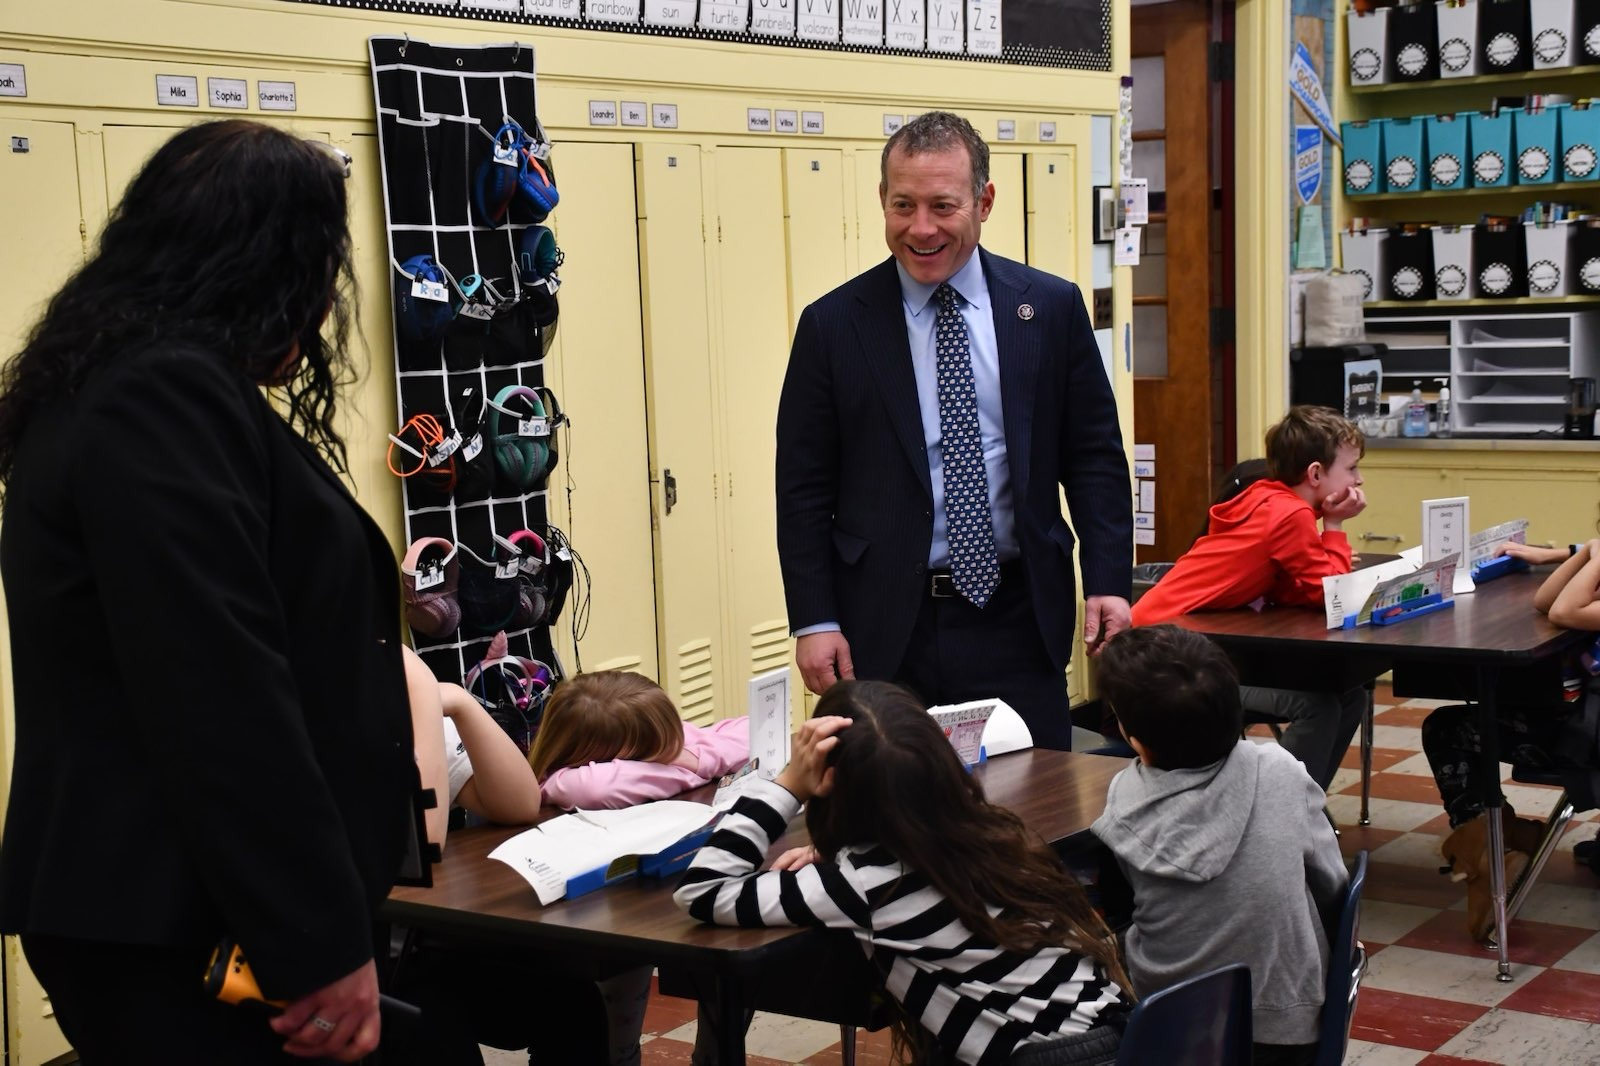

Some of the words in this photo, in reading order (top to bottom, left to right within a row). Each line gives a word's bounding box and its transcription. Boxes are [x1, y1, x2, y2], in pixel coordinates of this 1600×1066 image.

[591, 2, 634, 16] rainbow
[661, 7, 680, 18] sun
[711, 7, 739, 26] turtle
[755, 16, 792, 31] umbrella
[802, 20, 834, 35] volcano
[1297, 68, 1320, 101] GOLD
[170, 86, 186, 97] Mila
[215, 90, 242, 103] Sophia
[260, 92, 287, 101] Charlotte
[592, 109, 614, 119] Leandro
[629, 111, 639, 119] Ben
